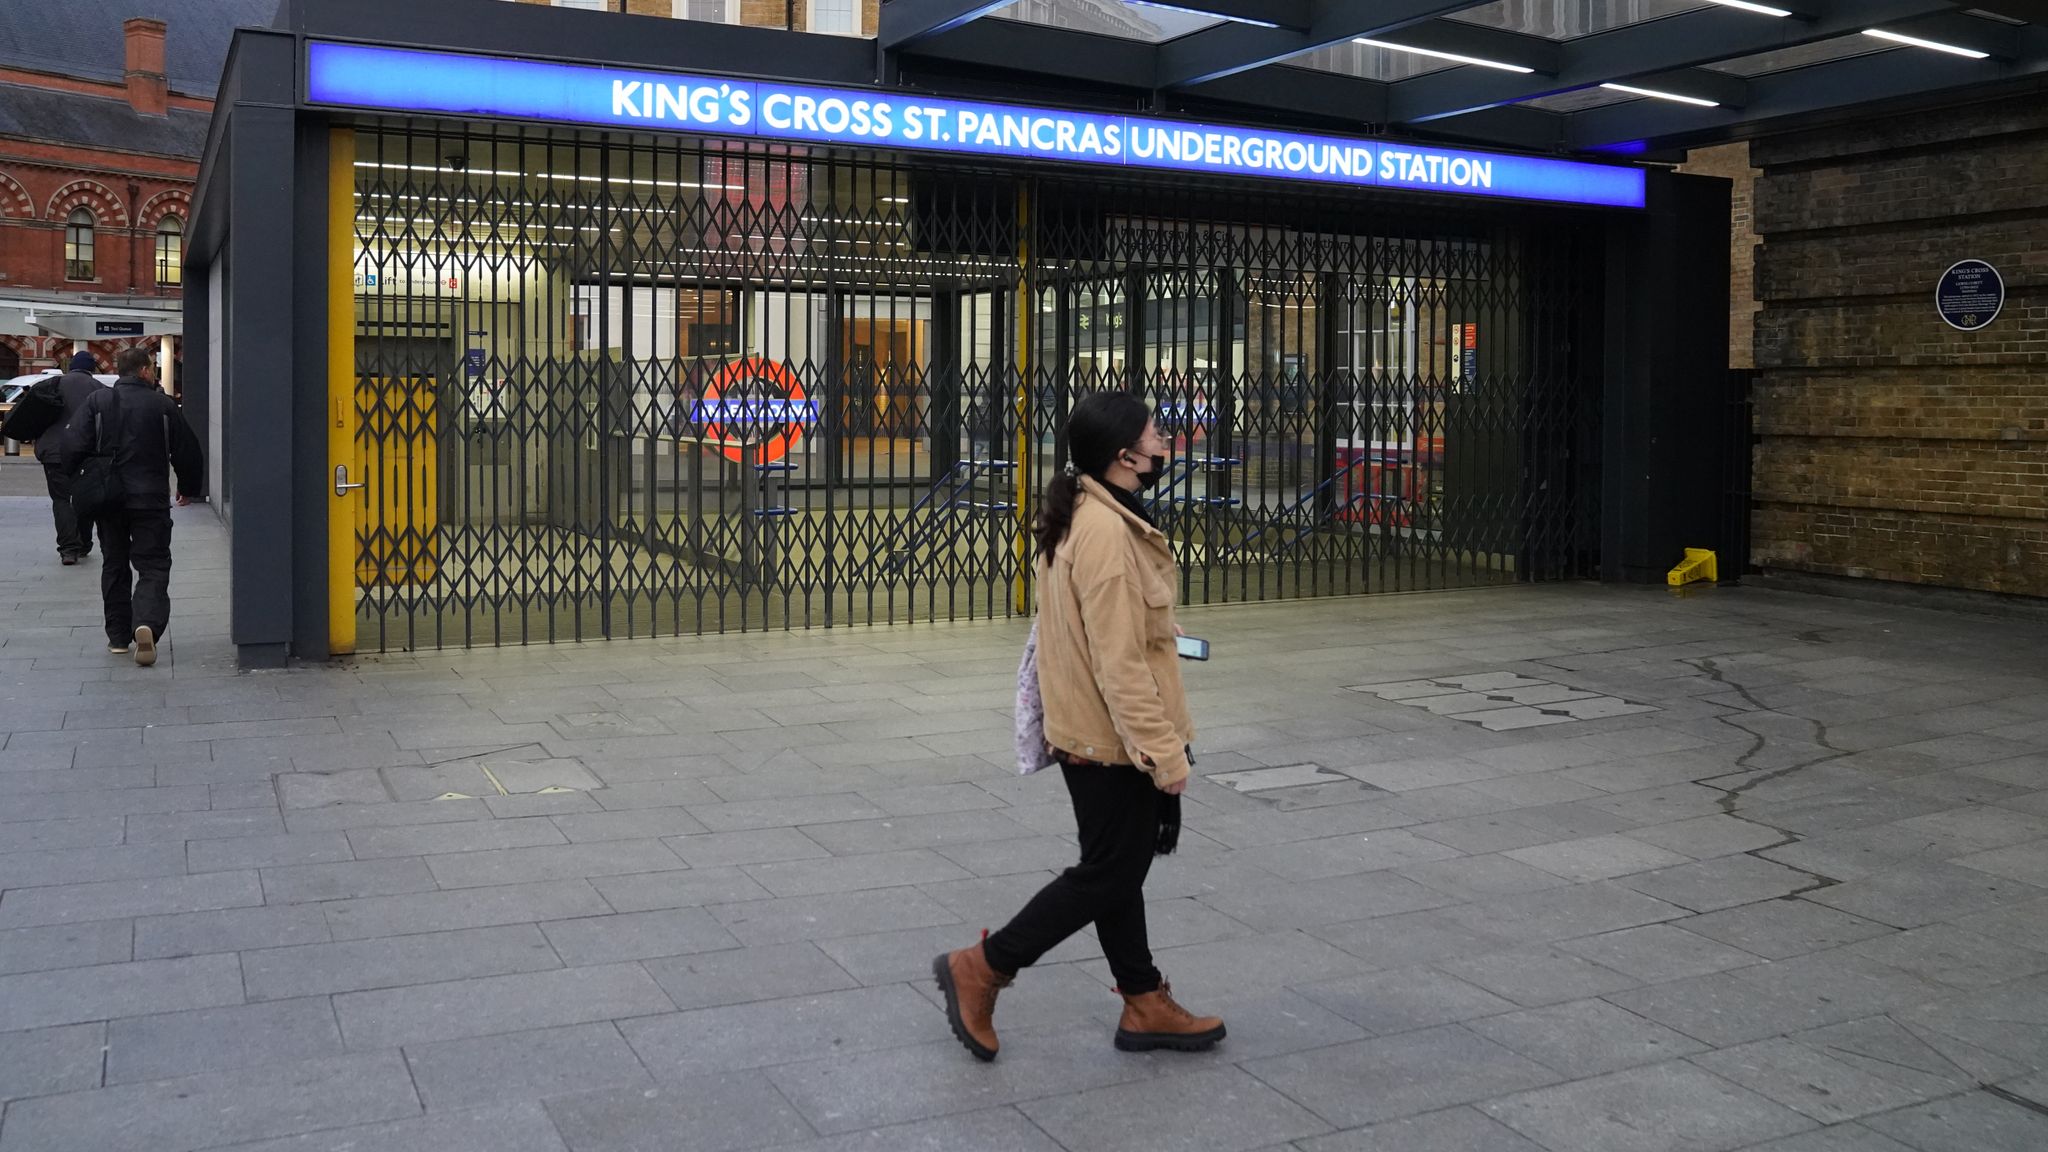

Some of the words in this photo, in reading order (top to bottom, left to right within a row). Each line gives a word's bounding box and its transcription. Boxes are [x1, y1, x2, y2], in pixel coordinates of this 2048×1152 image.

[612, 79, 752, 126] KING'S
[762, 93, 894, 138] CROSS
[902, 105, 951, 142] ST.
[957, 110, 1121, 156] PANCRAS
[1131, 126, 1373, 177] UNDERGROUND
[1379, 150, 1492, 188] STATION
[1304, 236, 1351, 250] Nrthrn
